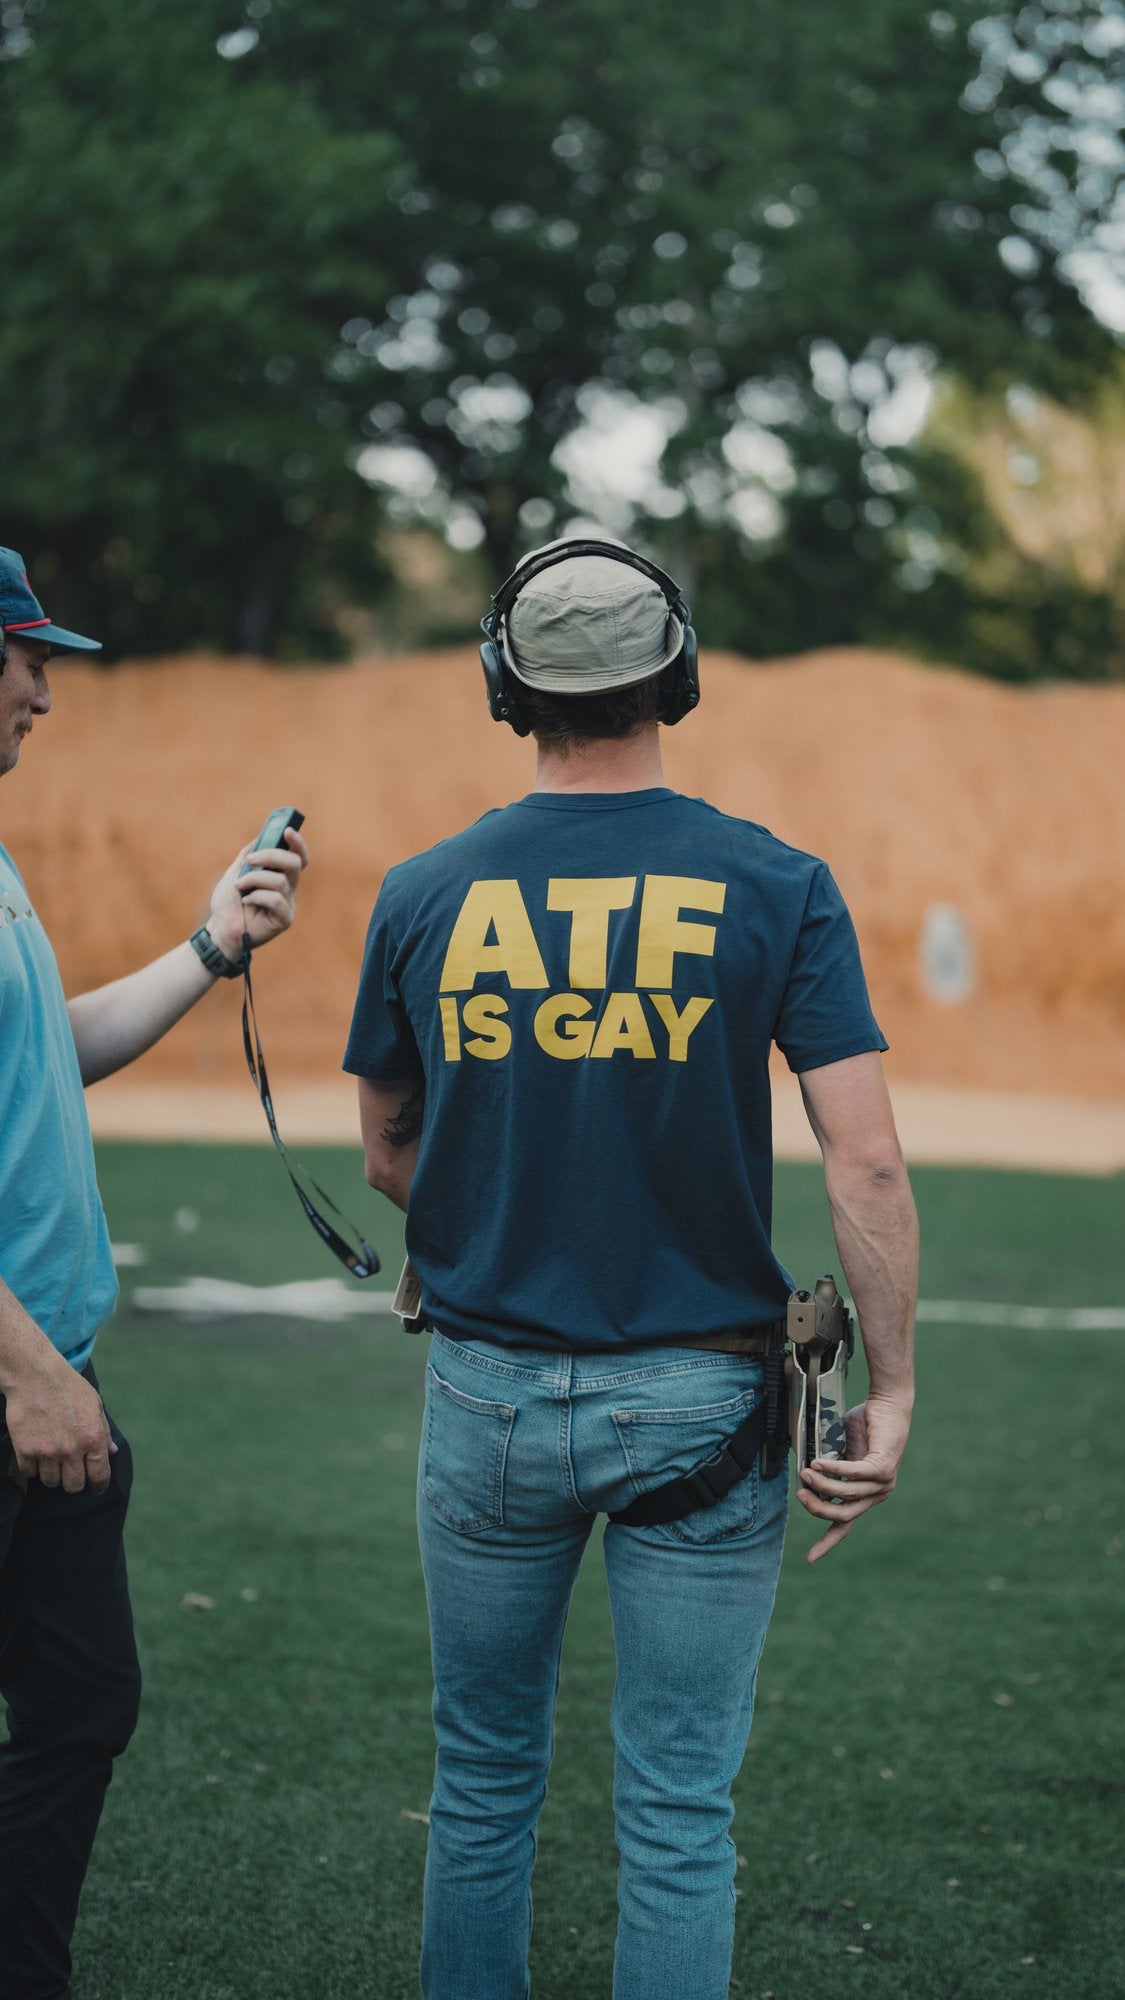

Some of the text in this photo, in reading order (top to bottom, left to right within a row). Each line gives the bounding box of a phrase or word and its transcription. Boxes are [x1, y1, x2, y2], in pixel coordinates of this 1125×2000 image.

[439, 874, 726, 992] ATF
[439, 992, 714, 1062] IS GAY
